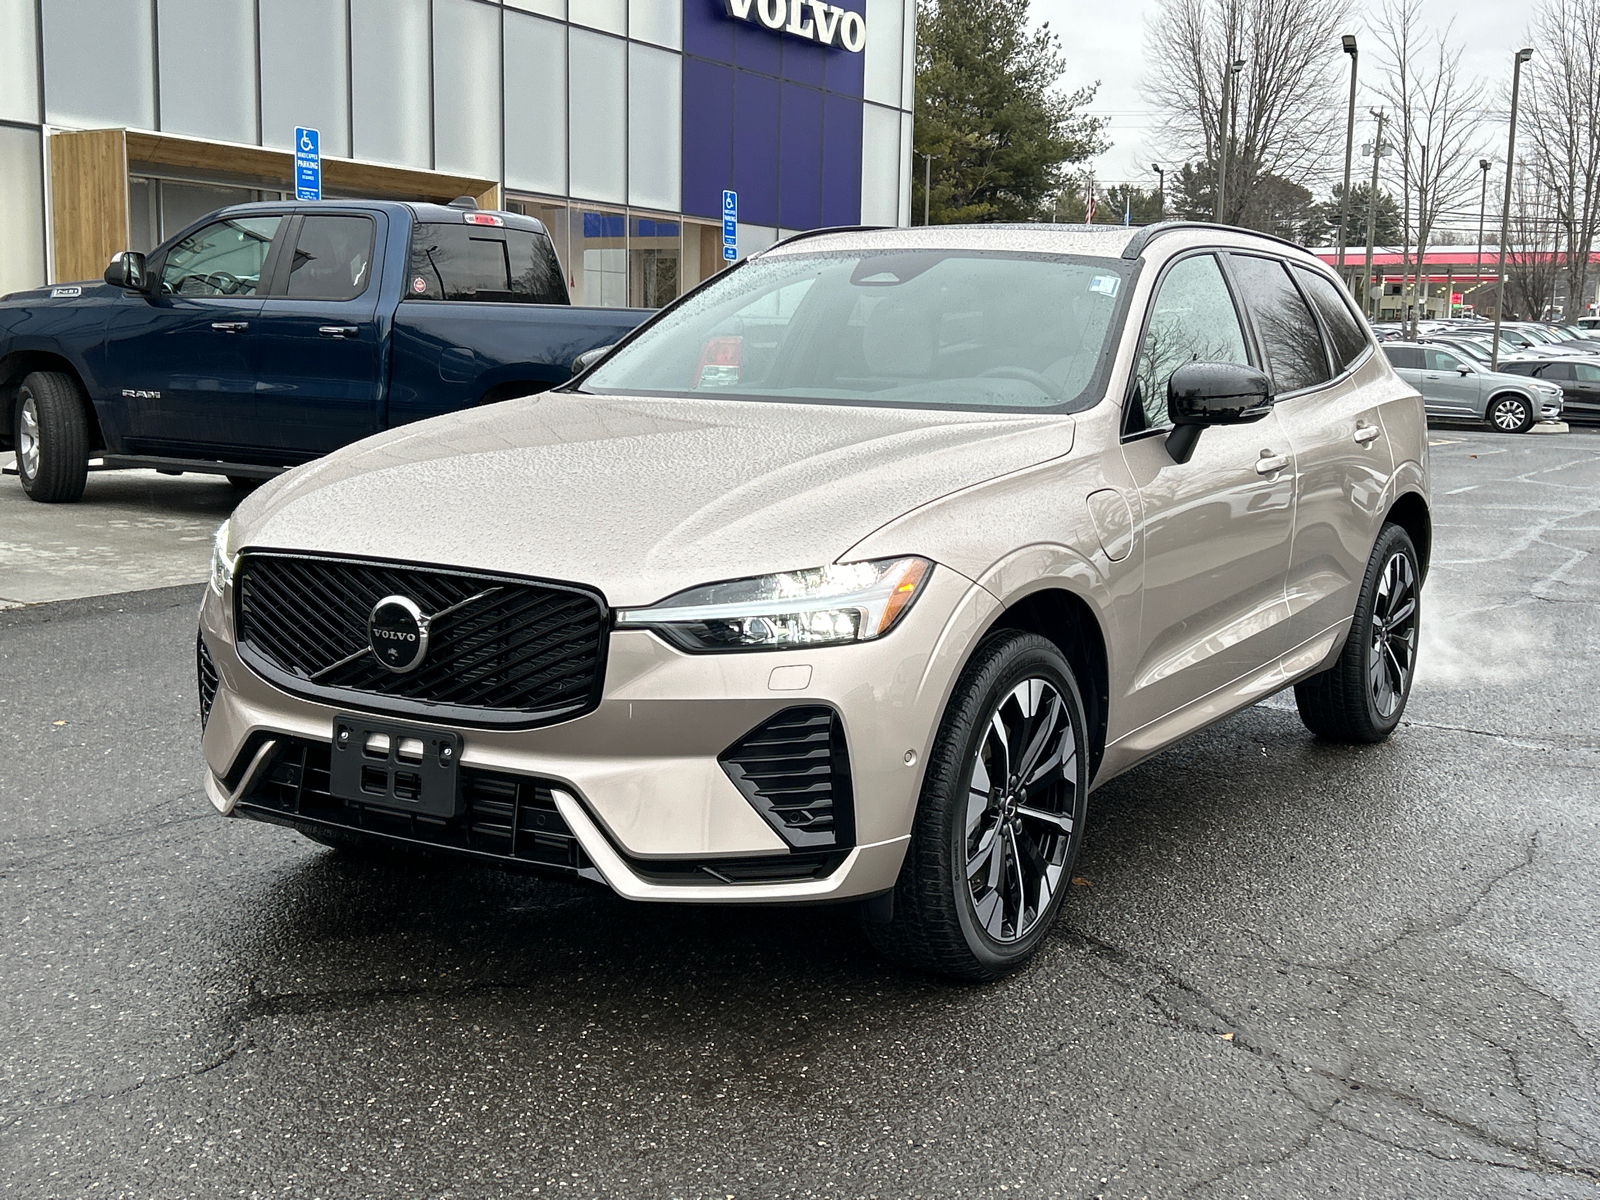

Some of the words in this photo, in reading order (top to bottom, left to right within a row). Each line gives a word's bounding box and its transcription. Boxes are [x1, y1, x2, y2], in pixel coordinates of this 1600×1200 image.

[298, 160, 318, 170] PARKING
[122, 389, 161, 399] RAM
[373, 628, 416, 642] VOLVO
